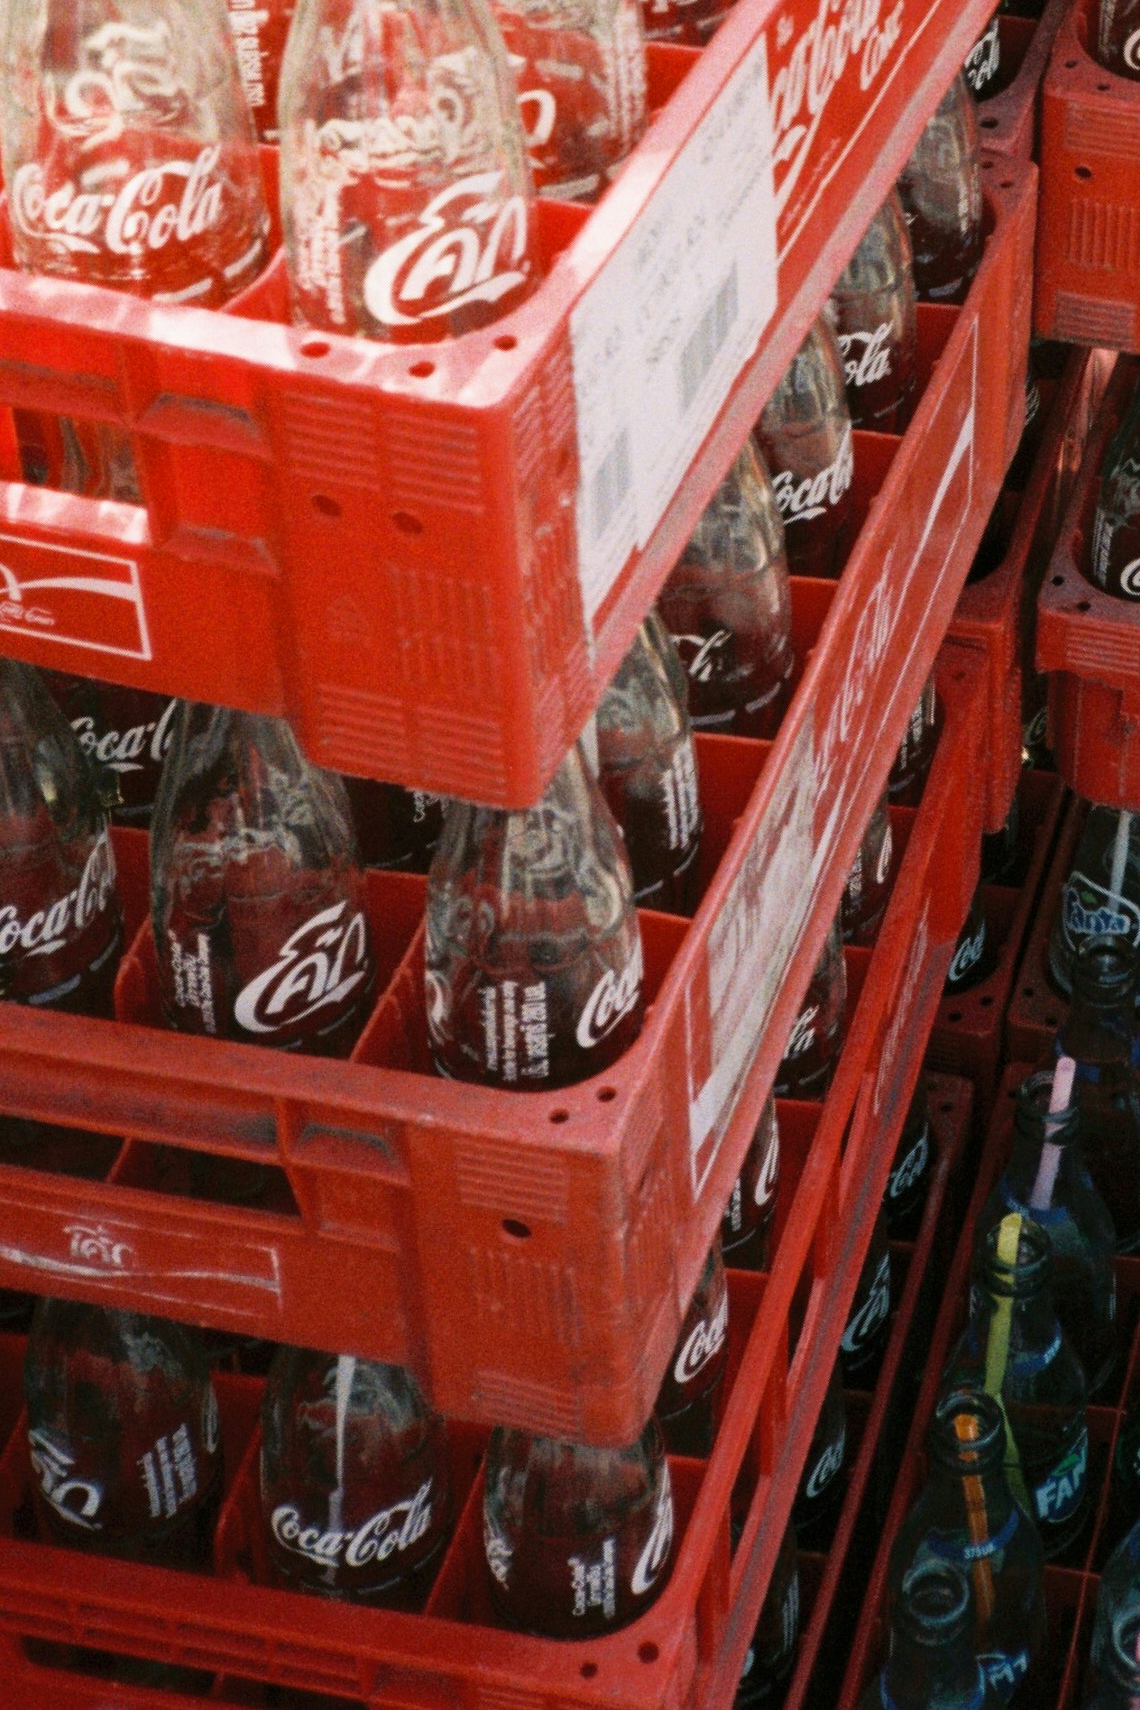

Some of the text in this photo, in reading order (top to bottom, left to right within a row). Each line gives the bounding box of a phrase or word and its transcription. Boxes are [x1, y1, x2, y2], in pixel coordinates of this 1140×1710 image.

[13, 144, 223, 255] Coca-Cola
[364, 171, 528, 326] โค้ก
[234, 899, 368, 1034] โค้ก
